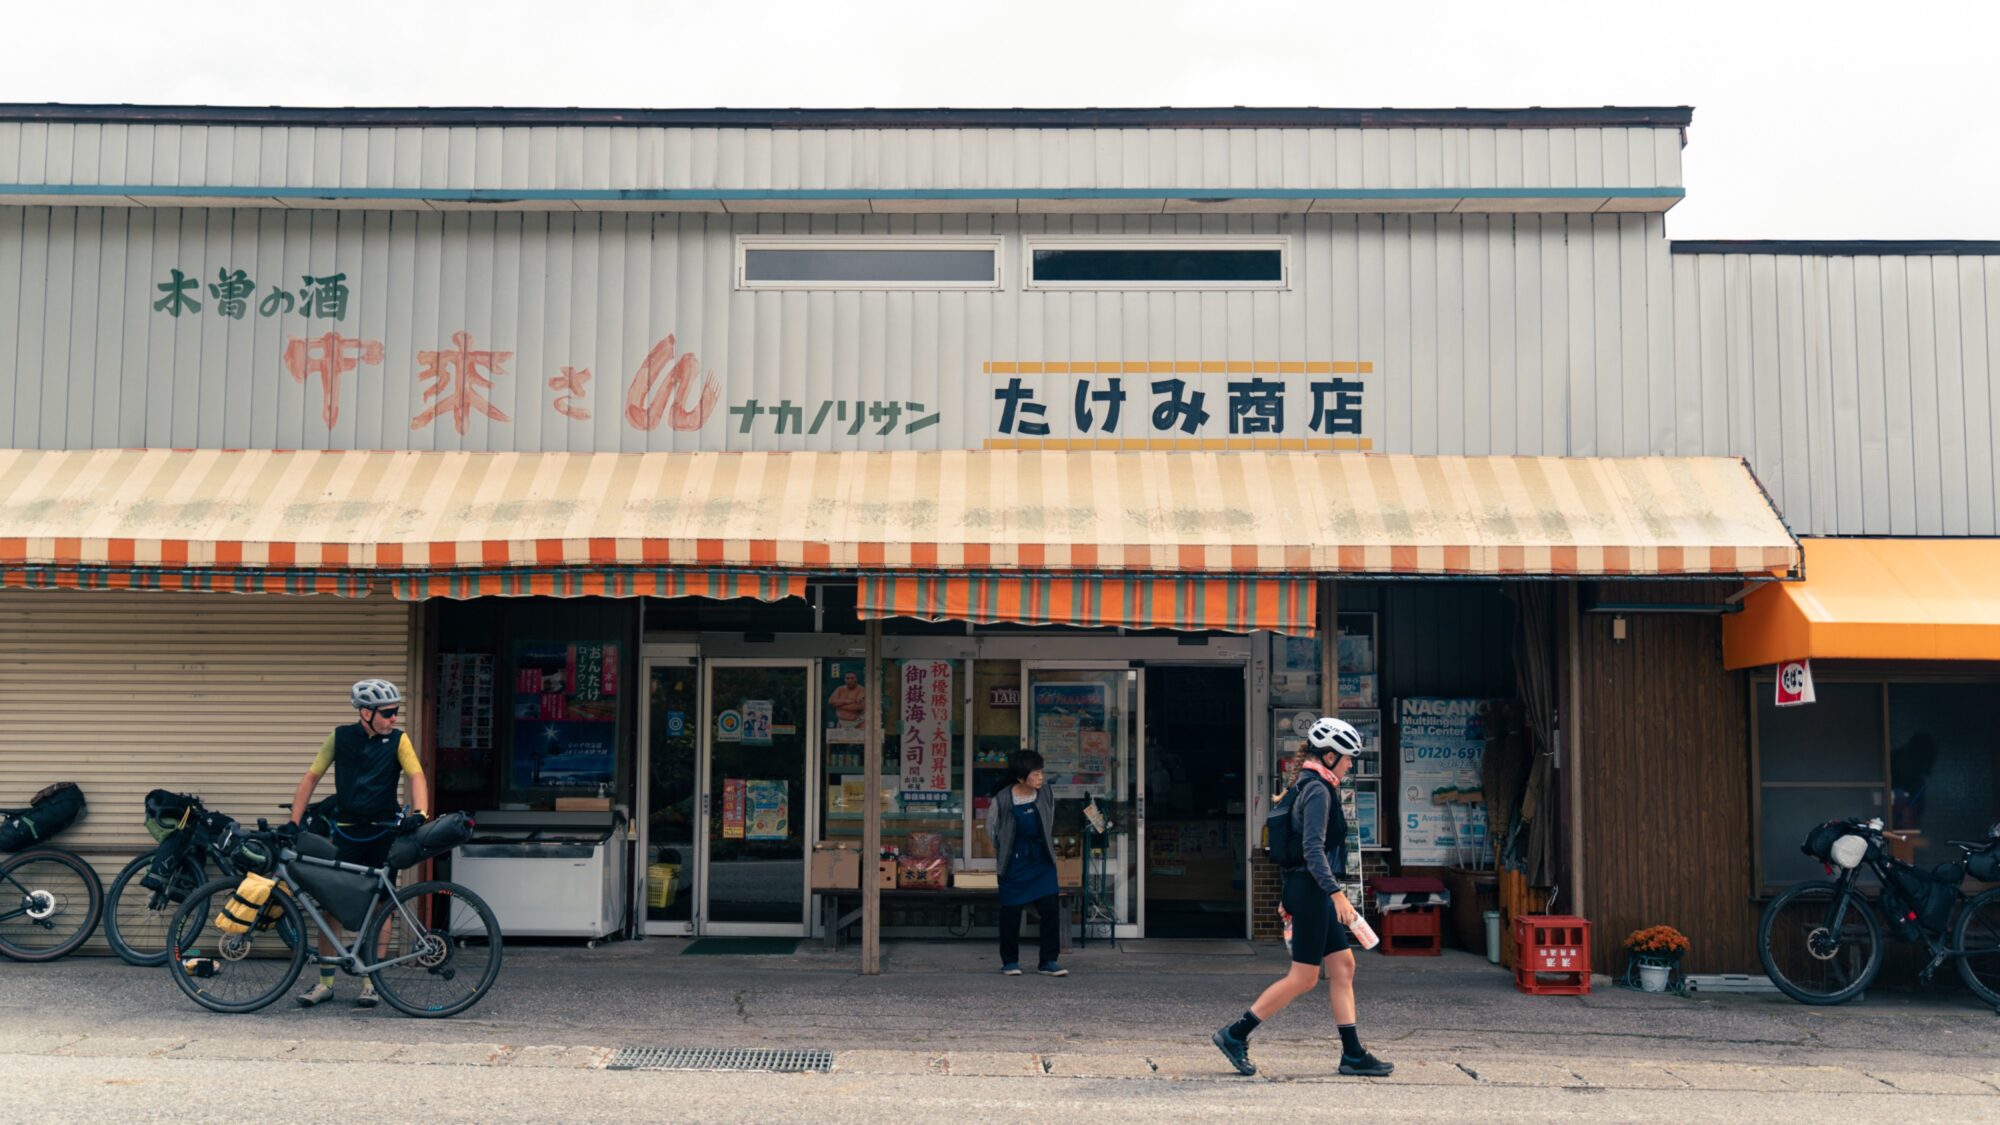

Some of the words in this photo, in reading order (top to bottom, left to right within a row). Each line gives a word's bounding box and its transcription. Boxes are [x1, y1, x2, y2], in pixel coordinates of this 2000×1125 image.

[154, 267, 349, 321] 木曽の酒
[994, 377, 1364, 435] たけみ商店
[730, 399, 940, 435] ナカノリサン
[588, 645, 601, 701] おんたけ
[1783, 668, 1803, 688] たばこ
[1402, 699, 1489, 716] NAGANO
[1298, 719, 1312, 730] 20
[1402, 716, 1467, 728] Multilingual
[1403, 726, 1425, 735] Call
[1427, 726, 1466, 736] Center
[1407, 814, 1419, 829] 5
